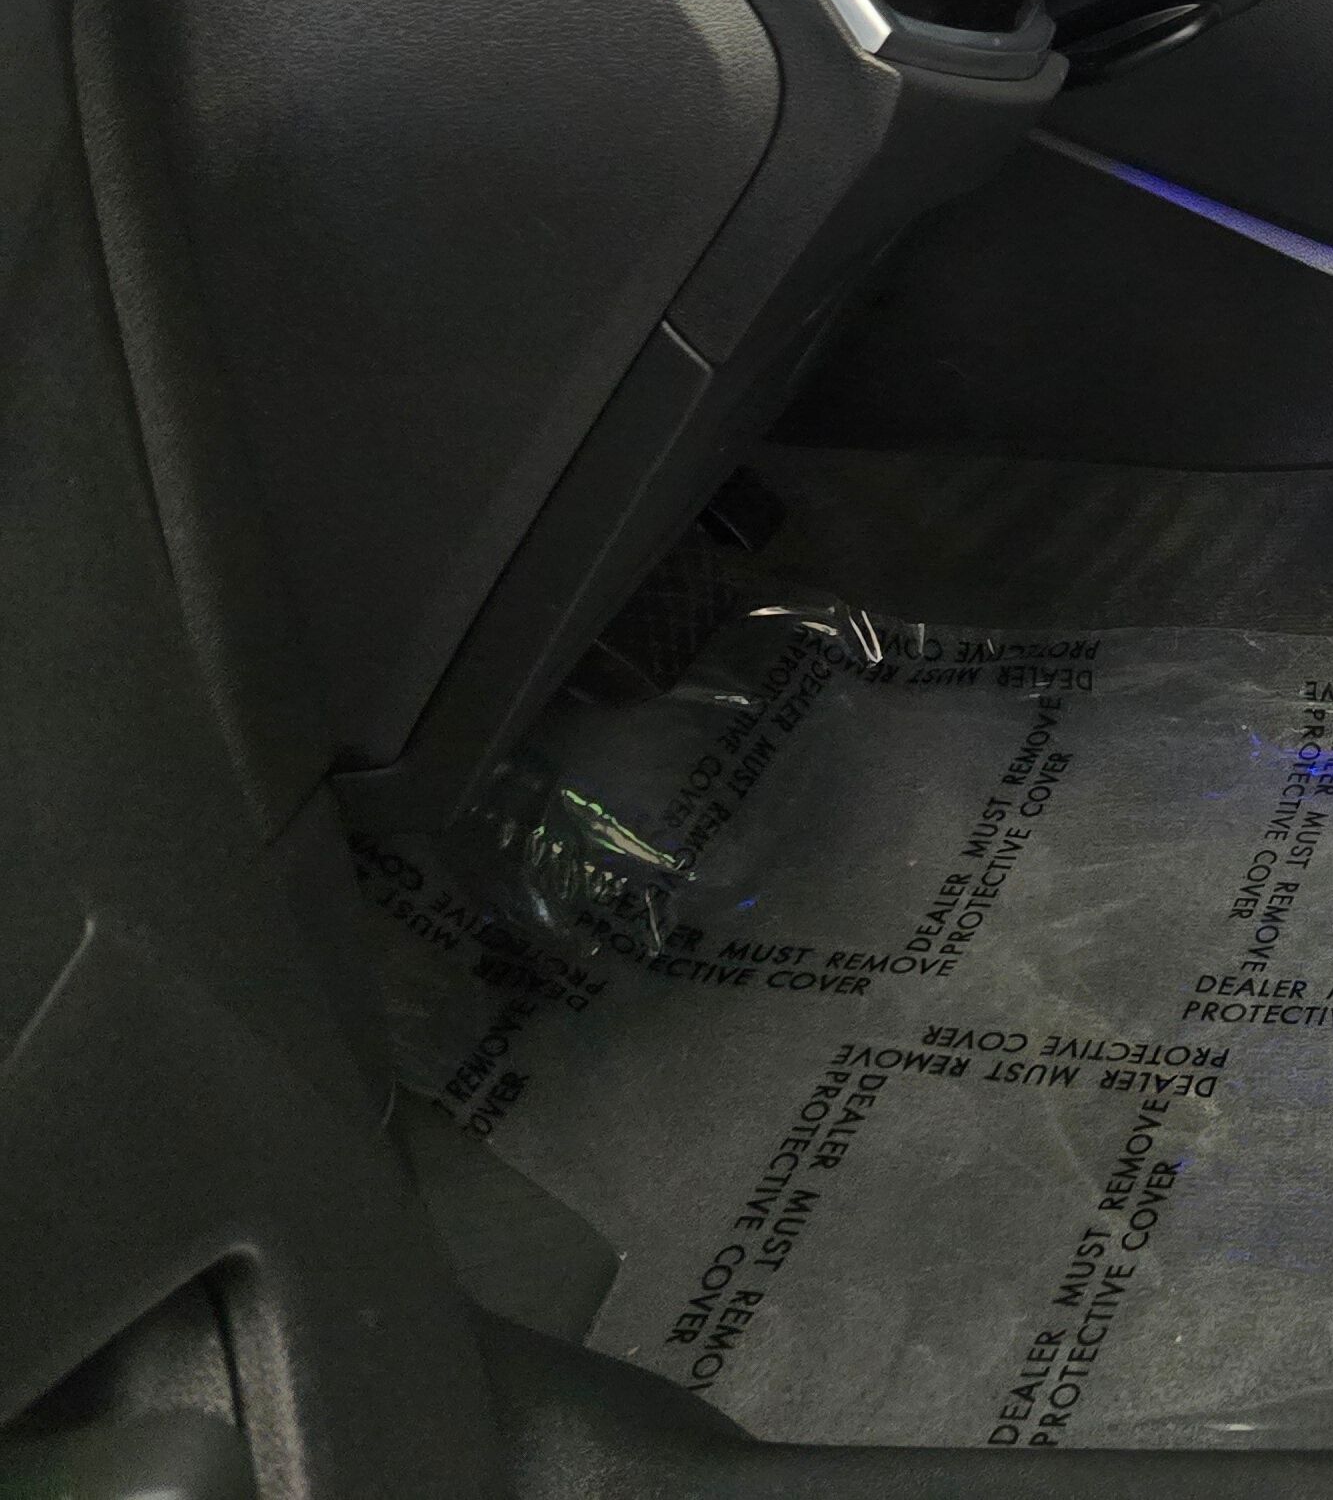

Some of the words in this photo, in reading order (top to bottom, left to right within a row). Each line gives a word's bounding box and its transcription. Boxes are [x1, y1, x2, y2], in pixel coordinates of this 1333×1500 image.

[1265, 707, 1326, 847] PROTECTIVE
[905, 873, 973, 953] DEALER
[960, 796, 1014, 858] MUST
[1002, 696, 1062, 786] REMOVE
[938, 827, 1031, 957] PROTECTIVE
[1019, 751, 1075, 819] COVER
[1285, 810, 1330, 870] MUST
[1228, 850, 1278, 920] COVER
[718, 939, 814, 967] MUST
[825, 950, 958, 978] REMOVE
[1240, 878, 1301, 975] REMOVE
[766, 970, 872, 996] COVER
[1194, 975, 1307, 1000] DEALER
[830, 1043, 972, 1079] REMOVE
[922, 1025, 1028, 1053] COVER
[984, 1059, 1081, 1087] MUST
[1039, 1034, 1230, 1069] PROTECTIVE
[1099, 1070, 1218, 1098] DEALER
[733, 1071, 851, 1232] PROTECTIVE
[808, 1074, 887, 1172] DEALER
[753, 1189, 821, 1272] MUST
[664, 1245, 745, 1346] COVER
[988, 1328, 1068, 1447] DEALER
[1055, 1227, 1112, 1308] MUST
[1099, 1099, 1169, 1212] REMOVE
[1028, 1265, 1135, 1448] PROTECTIVE
[1122, 1159, 1185, 1252] COVER
